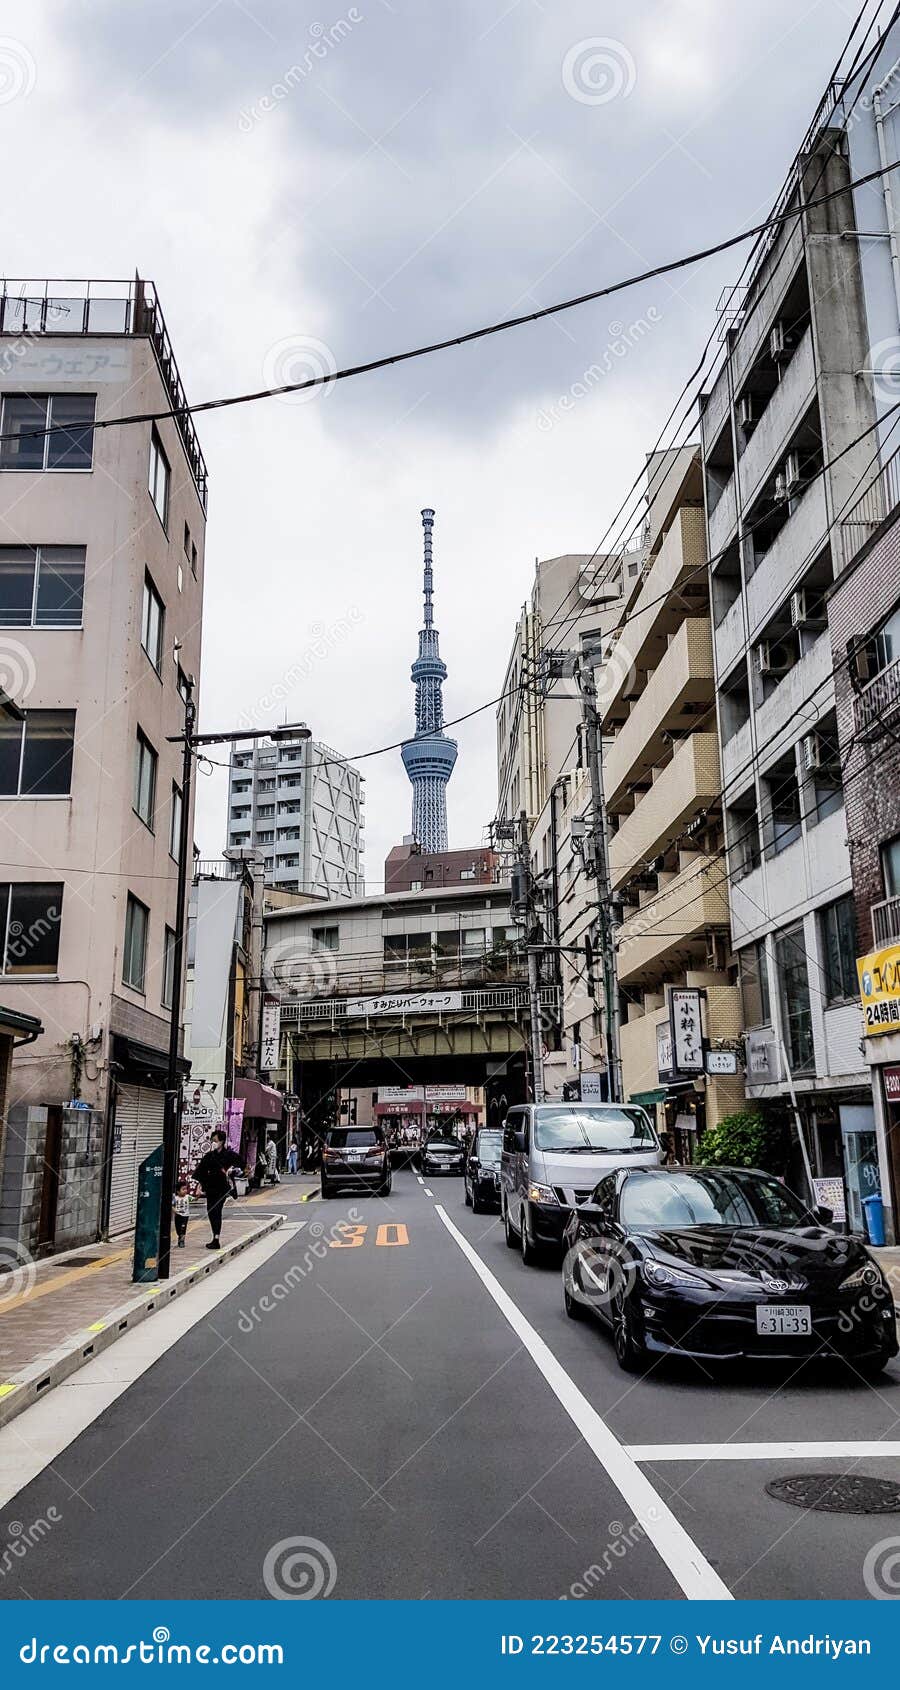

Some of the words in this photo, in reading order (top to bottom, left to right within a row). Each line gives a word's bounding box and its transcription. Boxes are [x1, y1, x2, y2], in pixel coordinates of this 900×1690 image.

[866, 998, 900, 1026] 24時間
[328, 1223, 410, 1248] 30
[769, 1317, 809, 1333] 31-39
